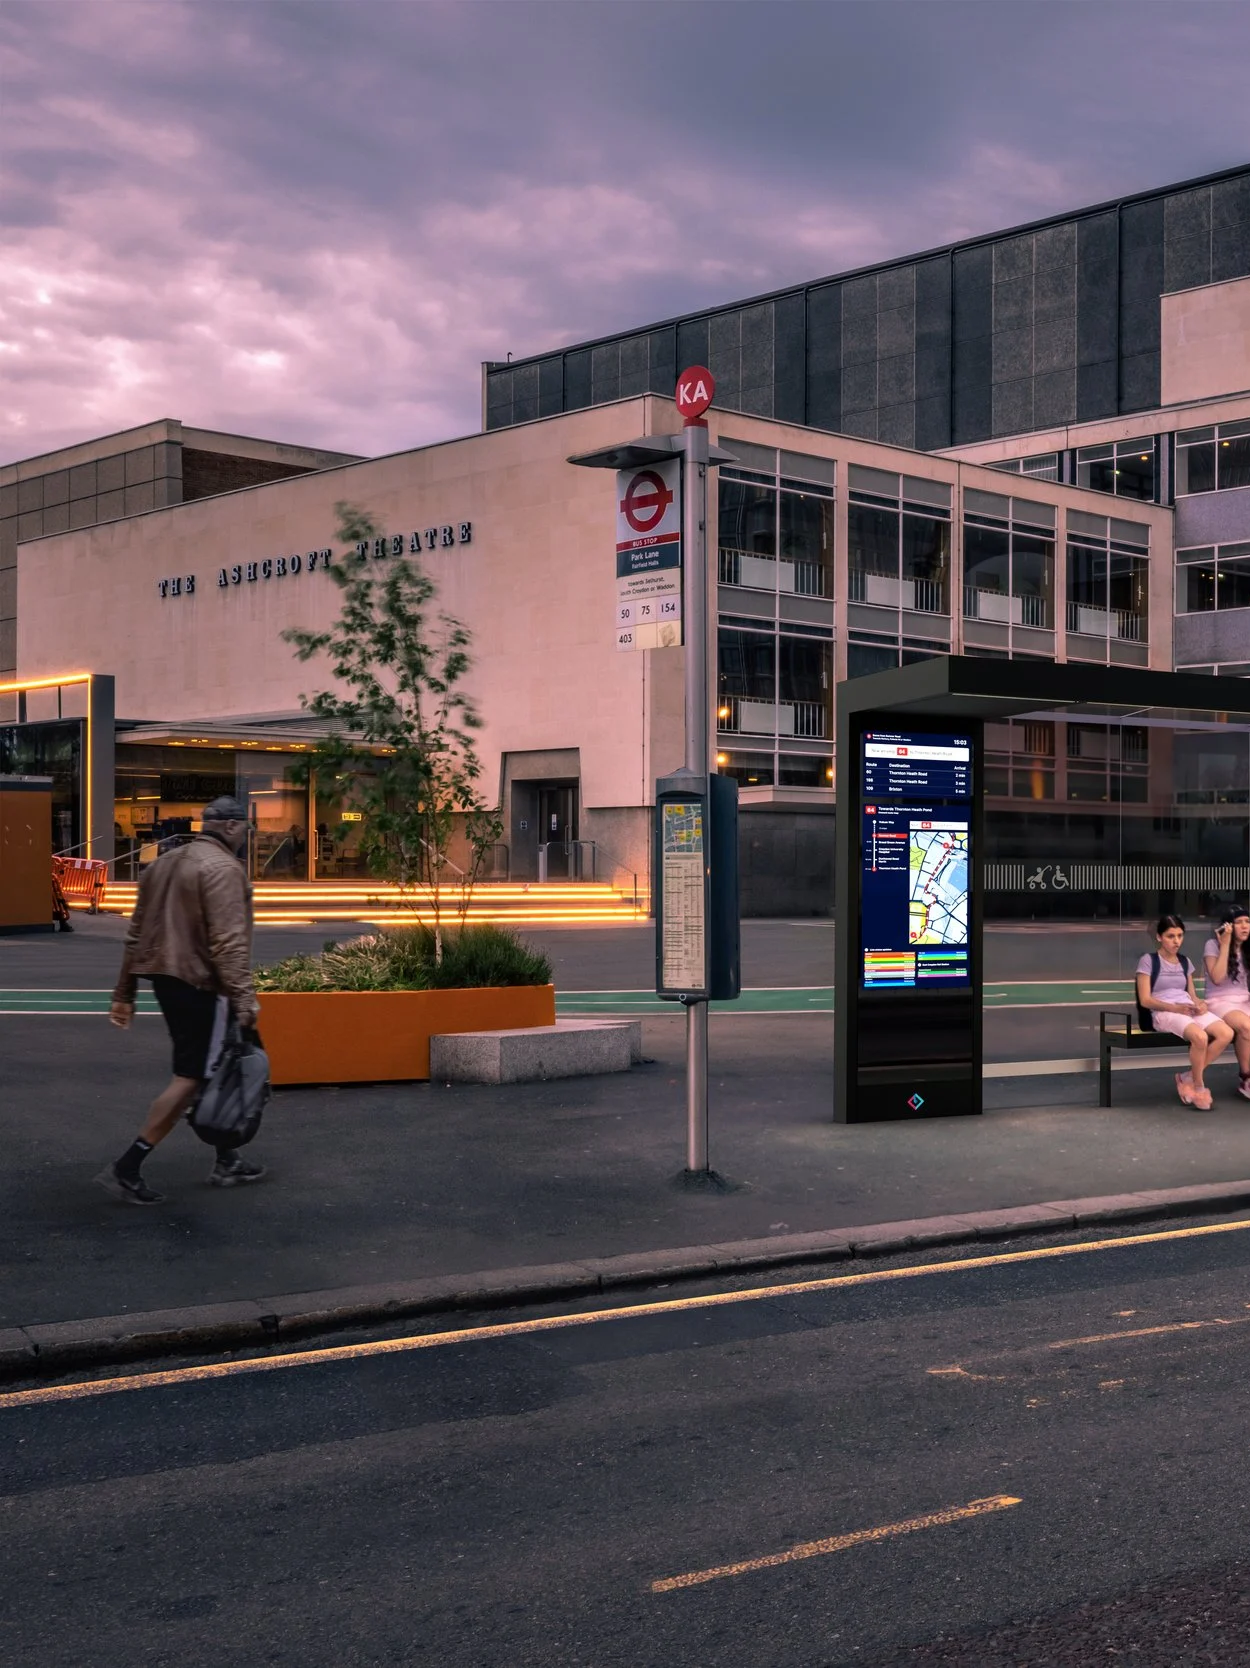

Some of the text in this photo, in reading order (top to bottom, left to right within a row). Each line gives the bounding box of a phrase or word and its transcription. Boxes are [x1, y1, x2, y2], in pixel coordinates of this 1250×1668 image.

[679, 380, 709, 406] KA
[632, 537, 658, 548] BUS STOP
[158, 521, 472, 598] THE ASHCROFT THEATRE
[631, 550, 660, 561] Park Lane
[621, 602, 676, 619] 50 75 154
[618, 633, 633, 644] 403
